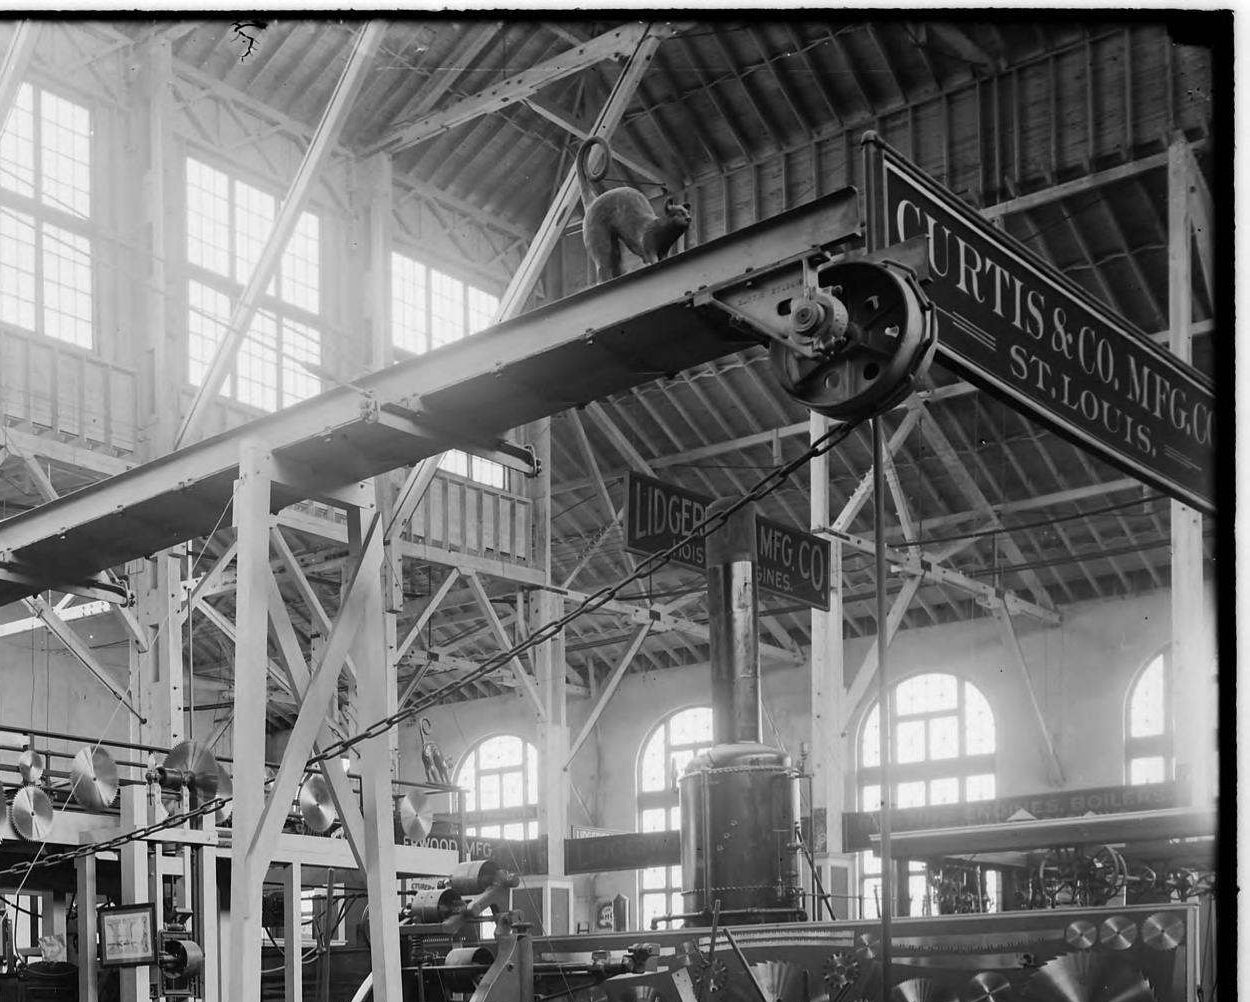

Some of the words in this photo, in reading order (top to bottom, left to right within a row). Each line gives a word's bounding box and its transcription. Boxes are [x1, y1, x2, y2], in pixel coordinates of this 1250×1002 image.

[896, 199, 1045, 340] CURTIS
[1051, 307, 1074, 360] &
[1078, 325, 1120, 391] CO.
[1062, 373, 1157, 458] LOUIS.
[760, 525, 795, 572] MFG.
